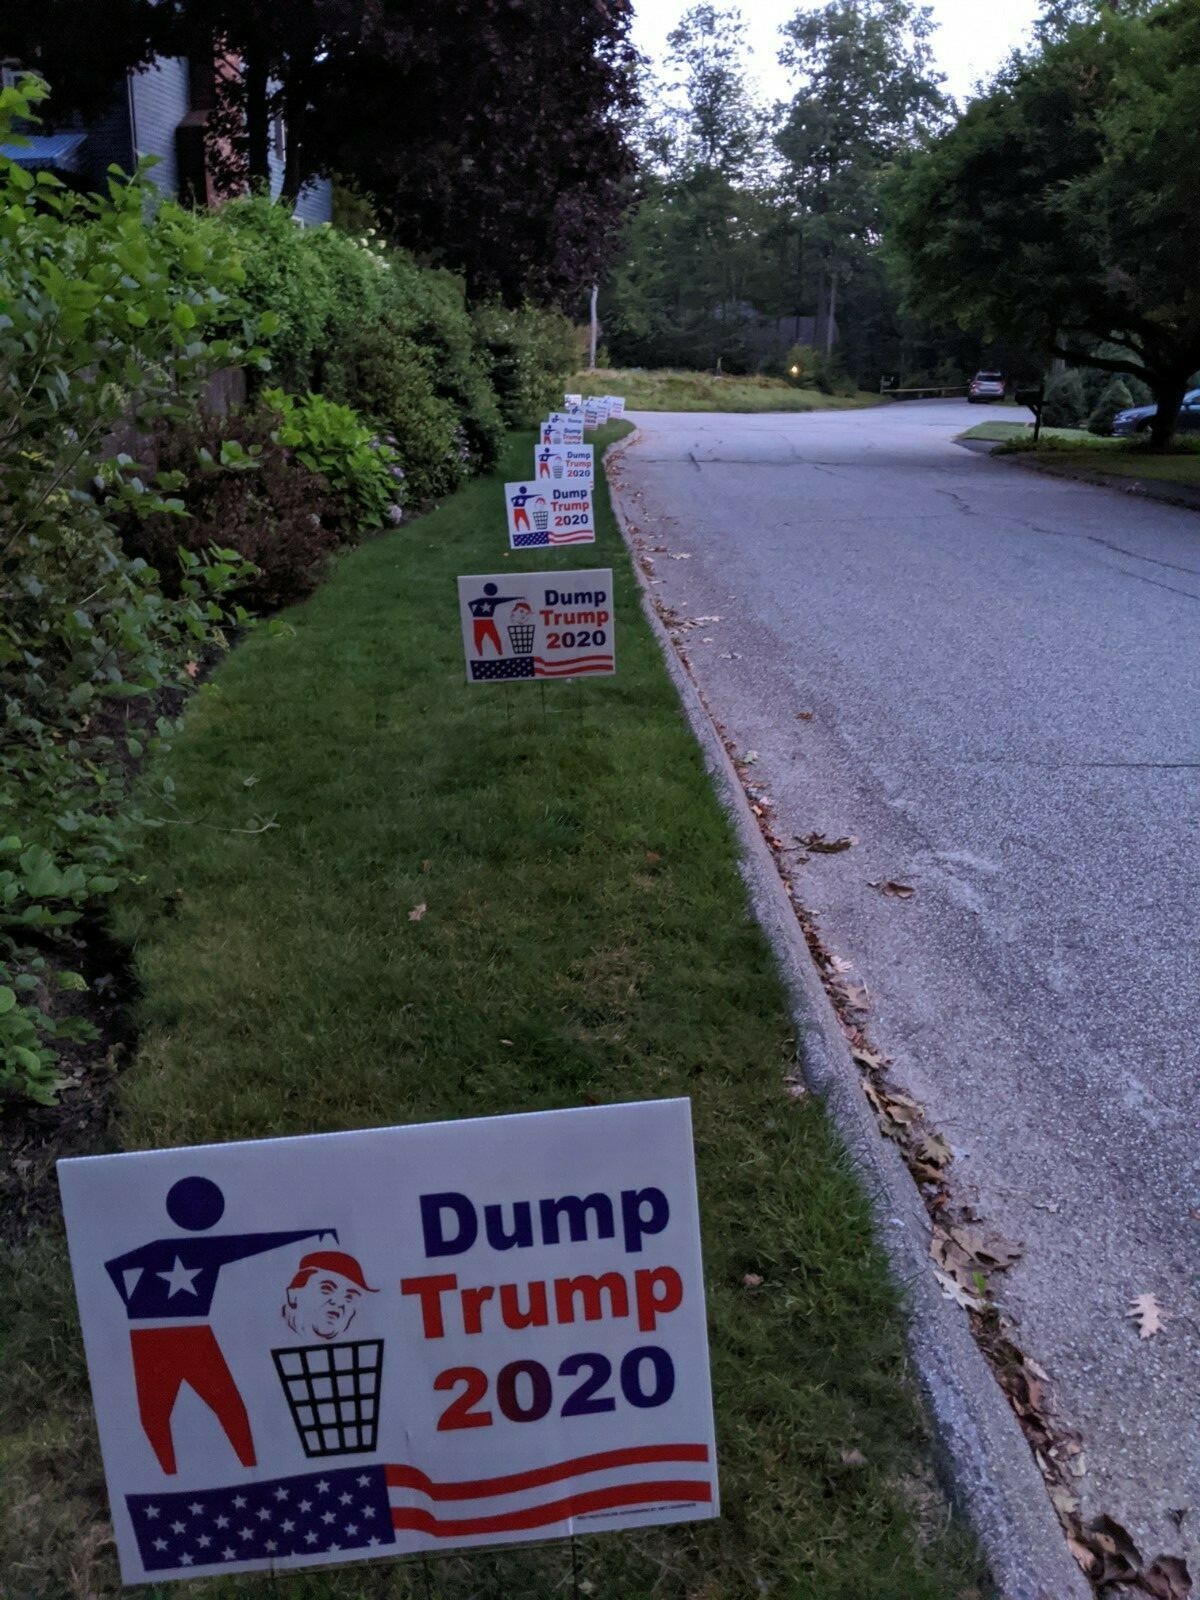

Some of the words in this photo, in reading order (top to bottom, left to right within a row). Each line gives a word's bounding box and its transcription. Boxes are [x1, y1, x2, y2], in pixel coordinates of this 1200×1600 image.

[567, 451, 591, 460] Dump
[565, 459, 592, 469] Trump
[567, 469, 591, 478] 2020
[553, 488, 588, 501] Dump
[550, 501, 590, 514] Trump
[554, 513, 589, 527] 2020
[544, 589, 607, 607] Dump
[539, 609, 609, 627] Trump
[546, 630, 606, 650] 2020
[420, 1186, 669, 1258] Dump
[401, 1265, 682, 1338] Trump
[433, 1345, 675, 1431] 2020
